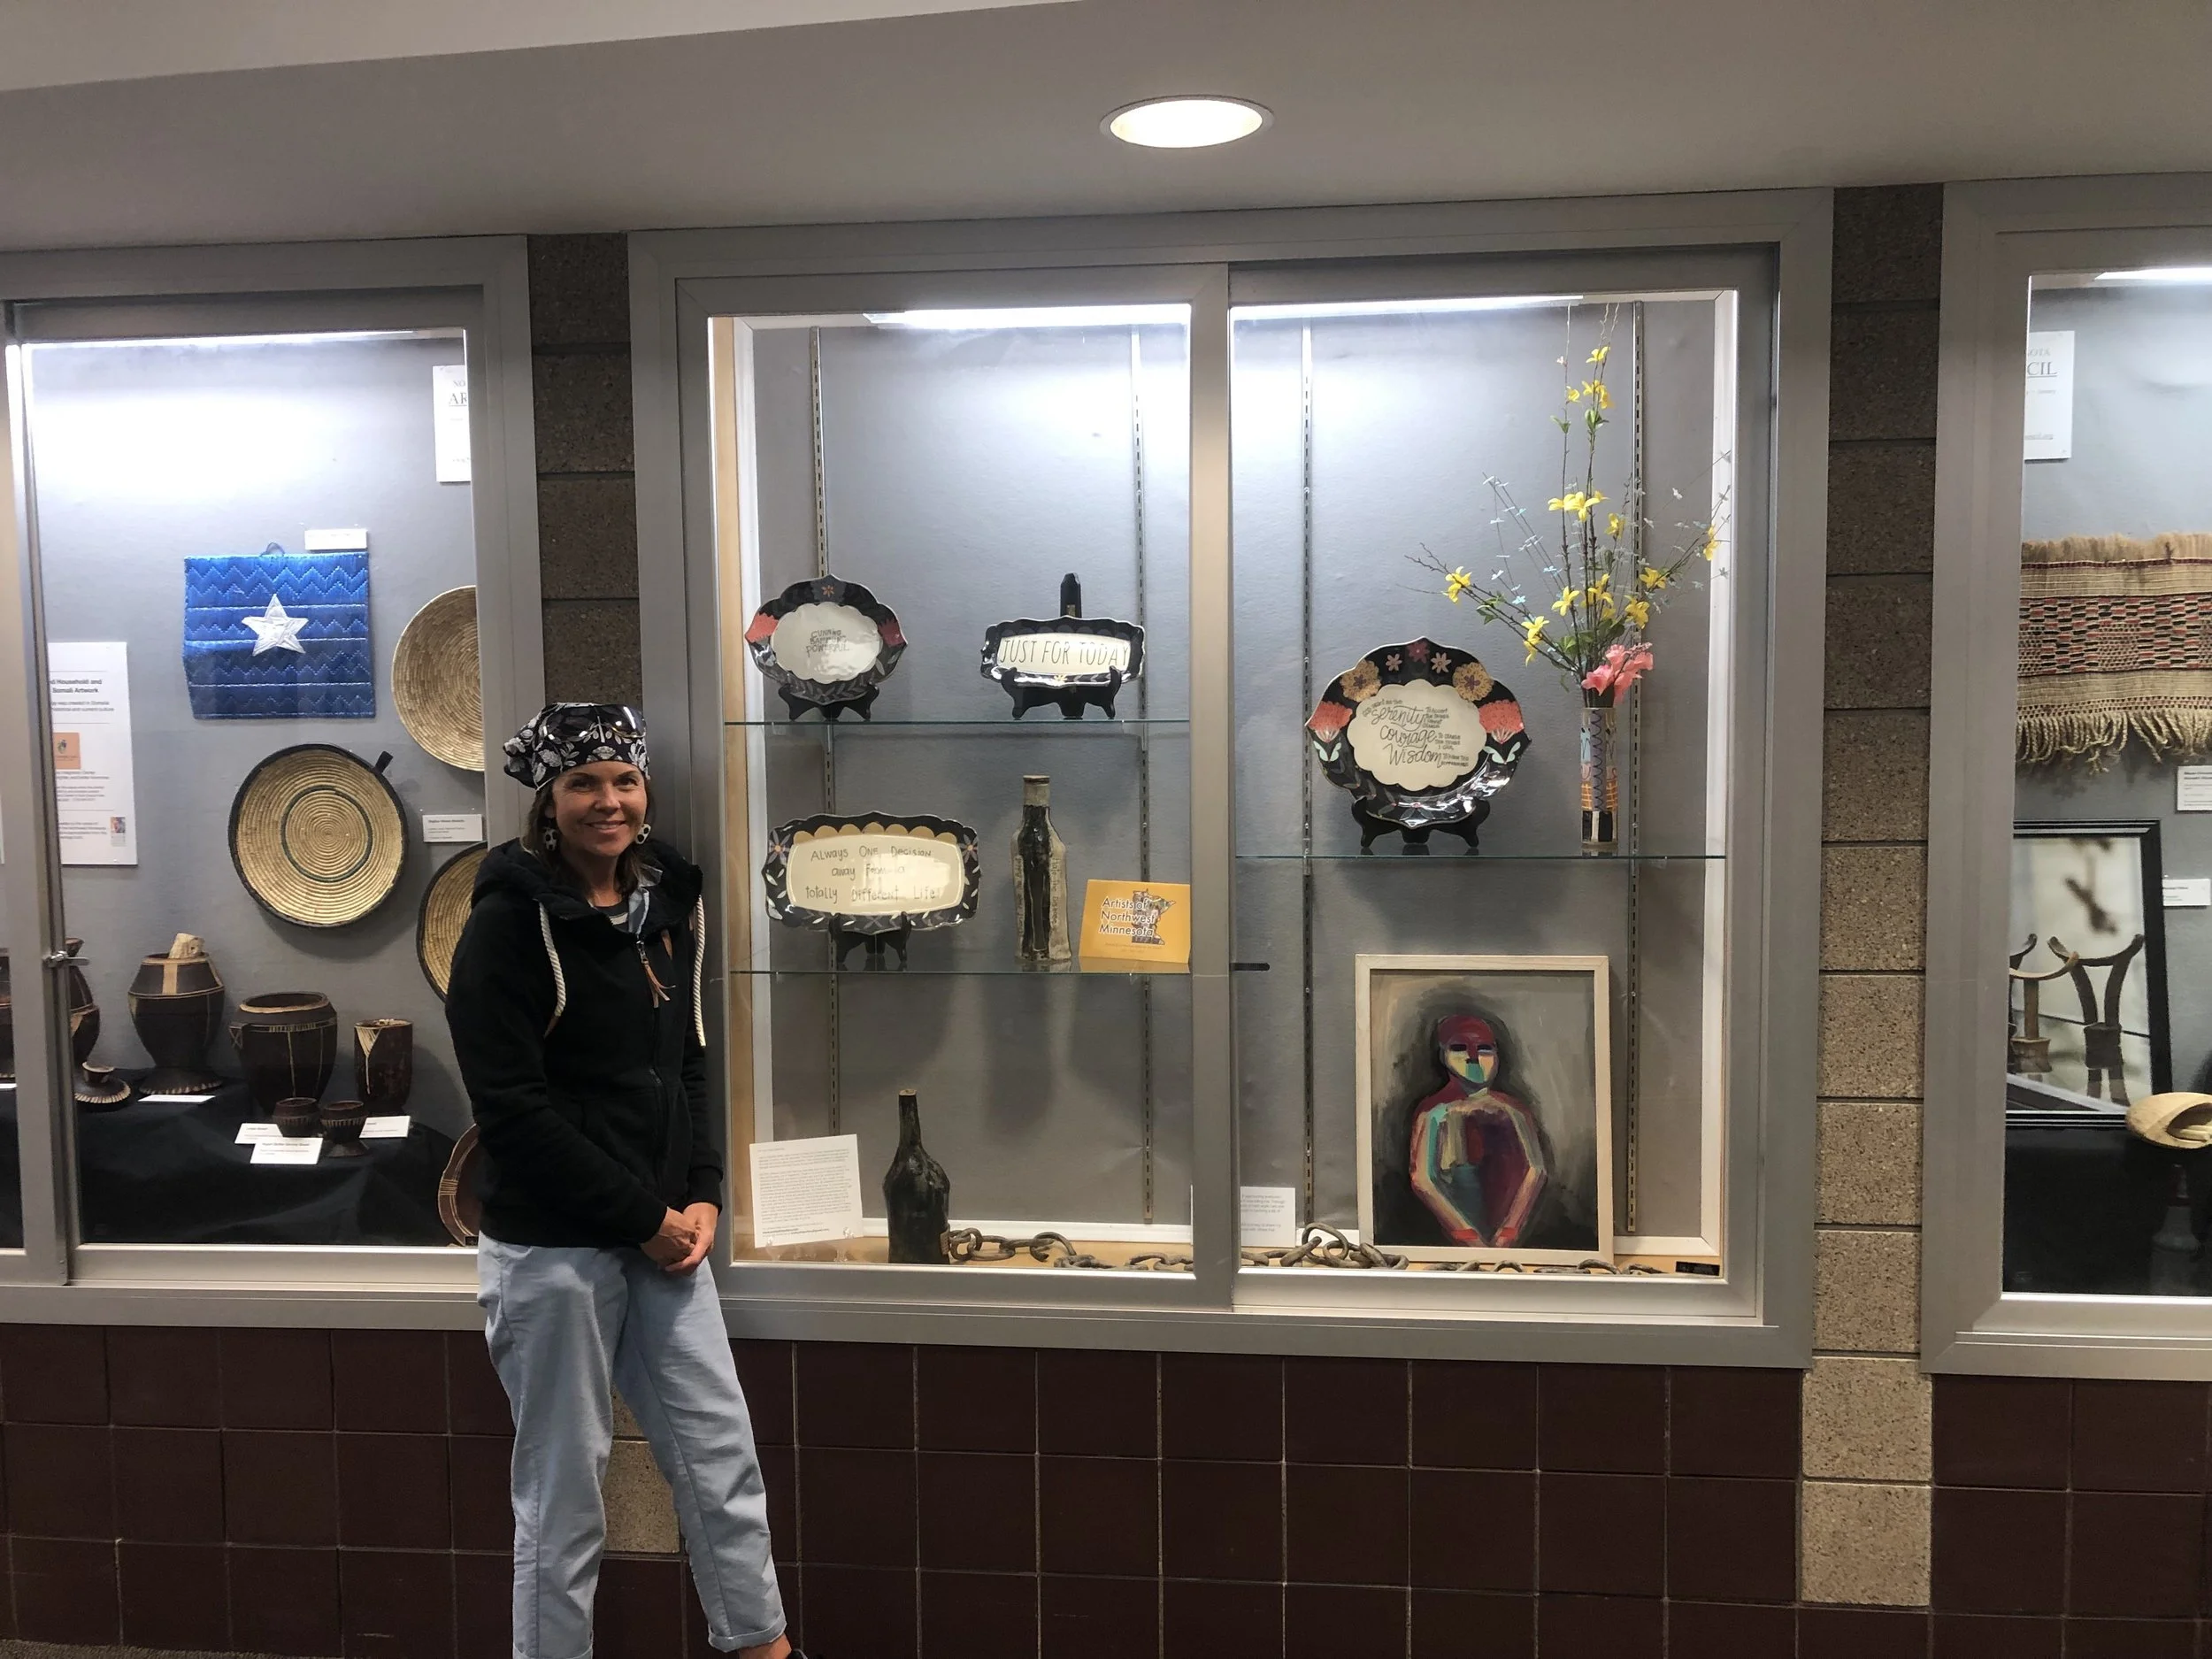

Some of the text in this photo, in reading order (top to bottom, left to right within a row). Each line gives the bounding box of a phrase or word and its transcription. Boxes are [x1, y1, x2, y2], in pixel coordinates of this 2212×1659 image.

[1000, 639, 1130, 666] JUST FOR TODAY
[831, 867, 856, 881] away
[805, 885, 839, 904] totally
[1102, 896, 1149, 910] Artists of
[1101, 910, 1156, 924] Northwest
[1099, 924, 1154, 937] Minnesota
